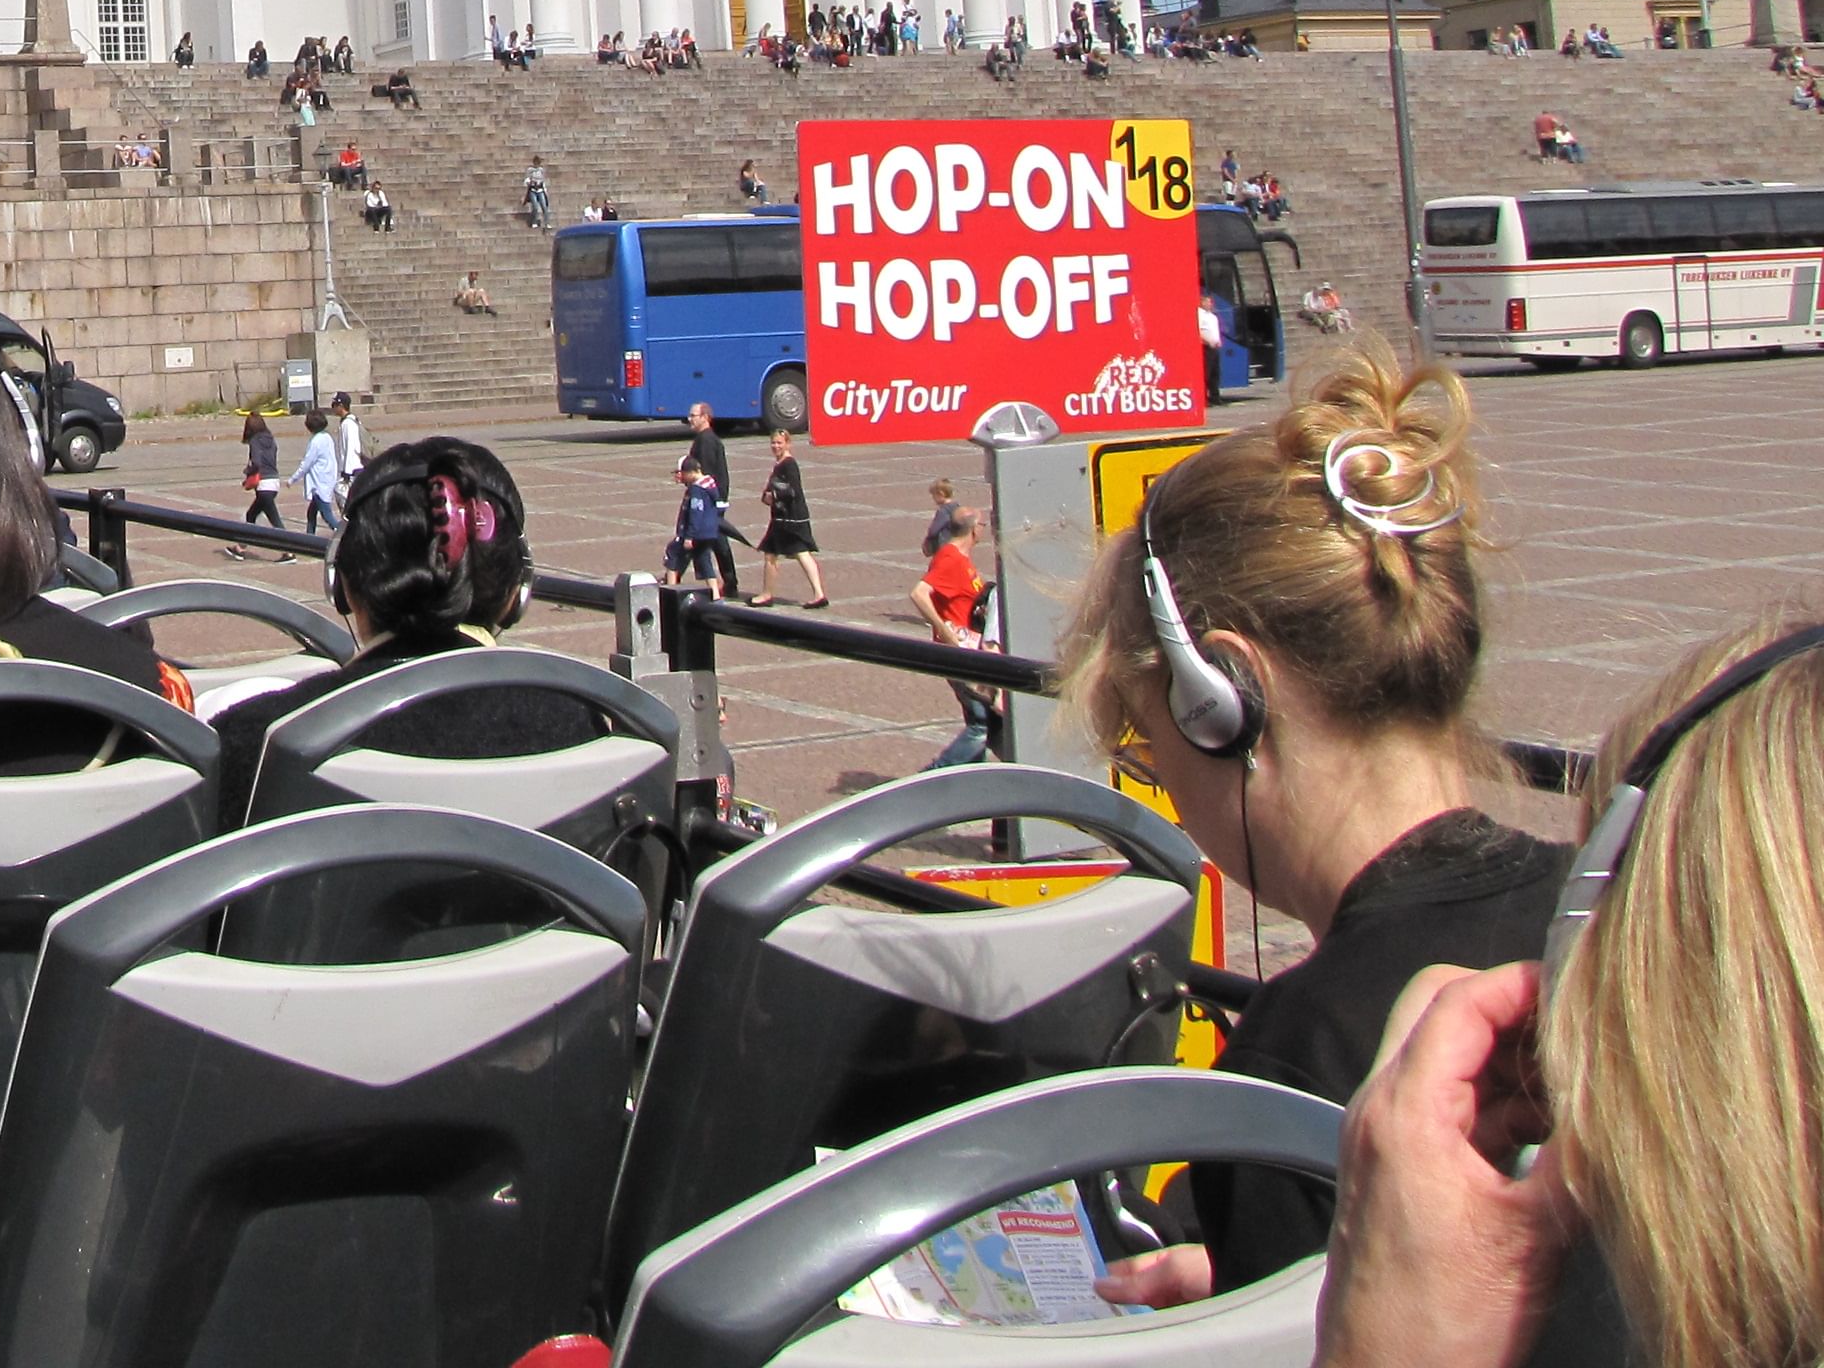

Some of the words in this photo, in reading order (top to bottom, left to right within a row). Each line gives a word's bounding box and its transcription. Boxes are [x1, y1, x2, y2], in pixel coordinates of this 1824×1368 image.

[812, 143, 1127, 235] HOP-ON
[818, 253, 1131, 341] HOP-OFF
[1109, 365, 1158, 387] RED
